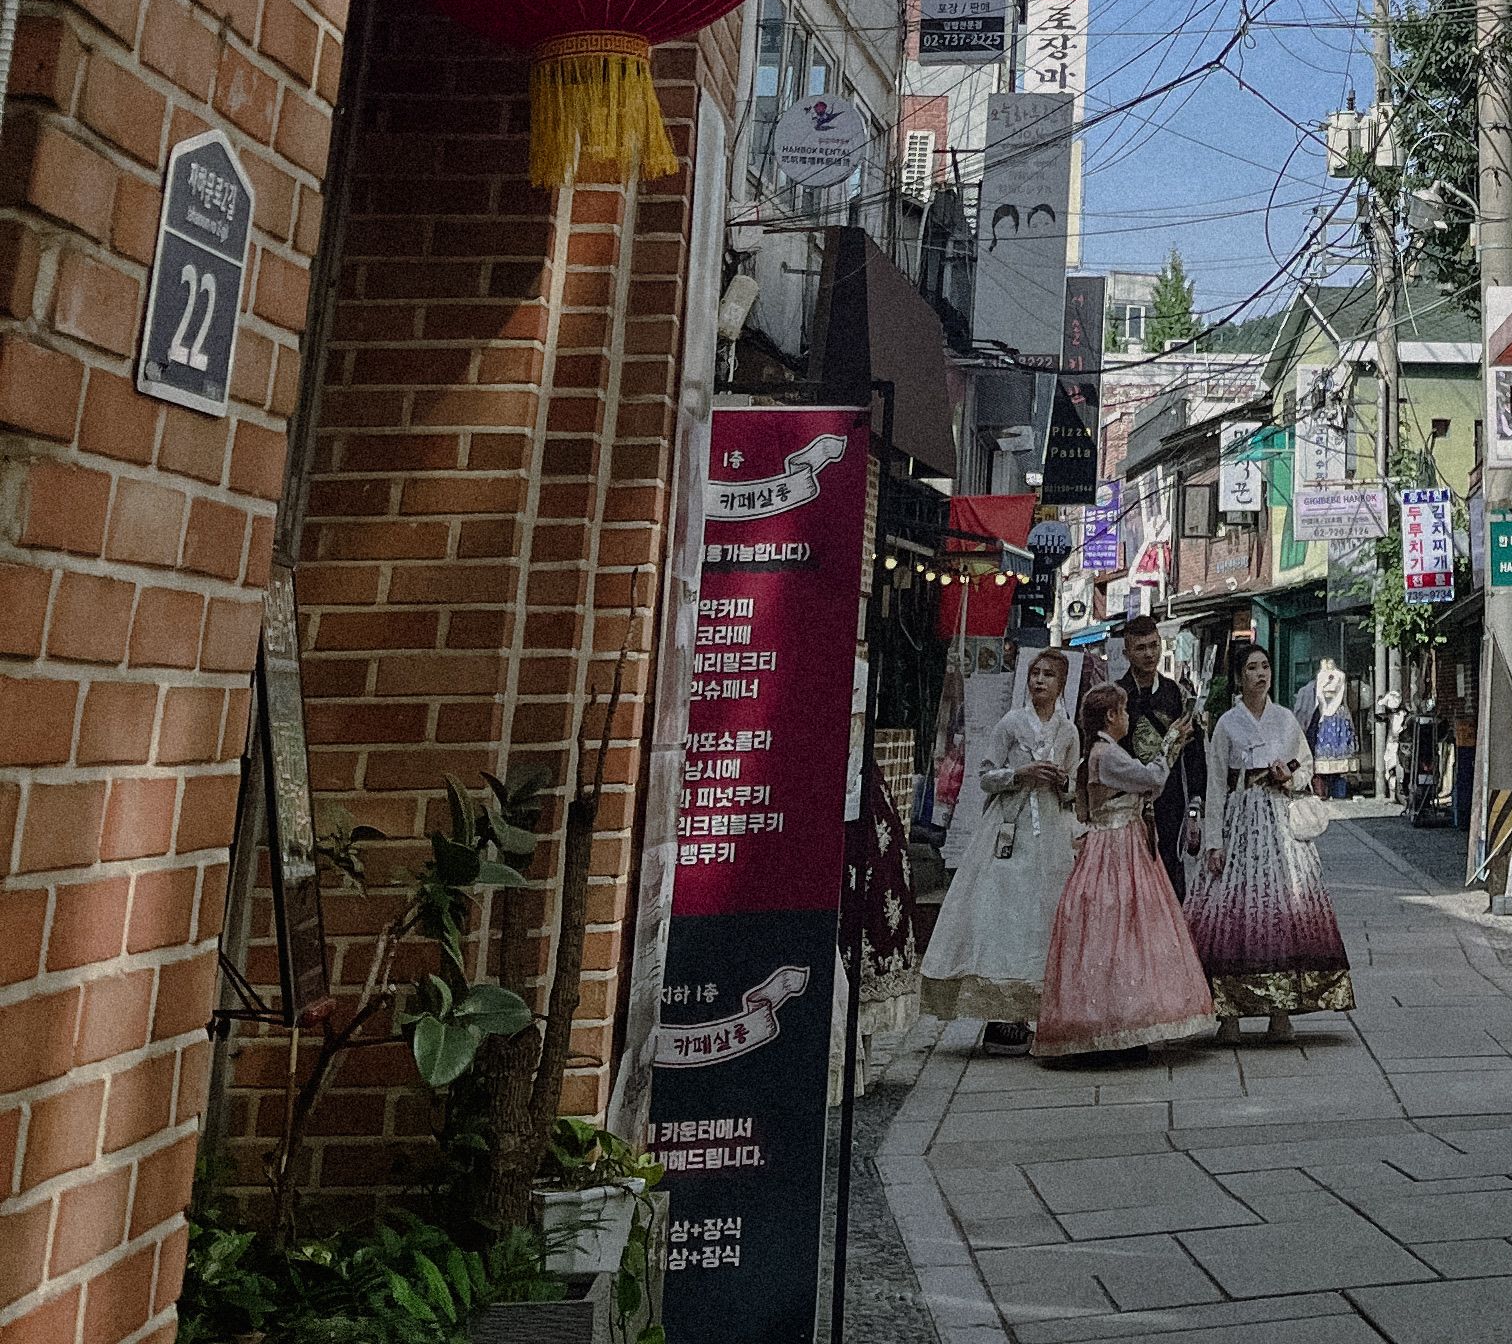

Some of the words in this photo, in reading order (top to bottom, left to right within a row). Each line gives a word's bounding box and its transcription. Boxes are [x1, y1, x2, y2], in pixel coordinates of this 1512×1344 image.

[167, 263, 217, 372] 22
[719, 482, 792, 512] 카페살롱
[673, 1023, 751, 1056] 카페살롱
